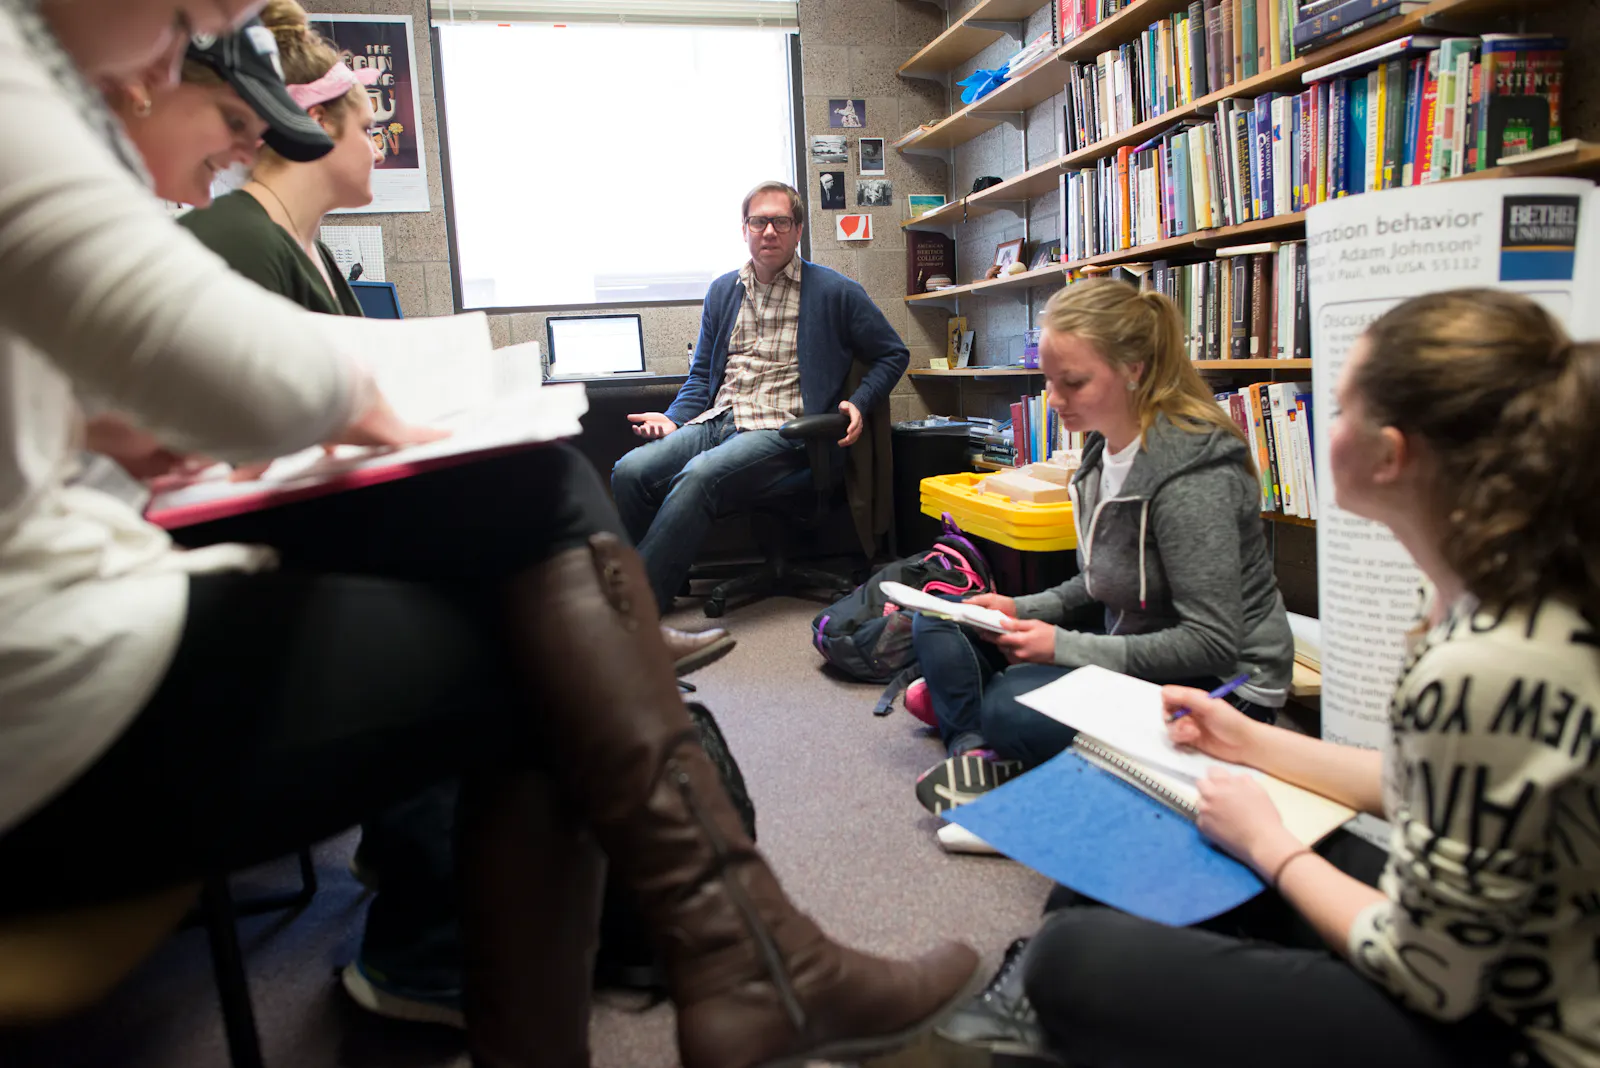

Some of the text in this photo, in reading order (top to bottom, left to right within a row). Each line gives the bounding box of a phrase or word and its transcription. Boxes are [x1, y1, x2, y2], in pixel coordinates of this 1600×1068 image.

[365, 44, 391, 54] THE
[1496, 72, 1563, 87] SCIENCE
[1376, 208, 1484, 236] behavior
[1510, 205, 1576, 225] BETHEL
[1339, 246, 1386, 262] Adam
[1395, 260, 1427, 275] USA
